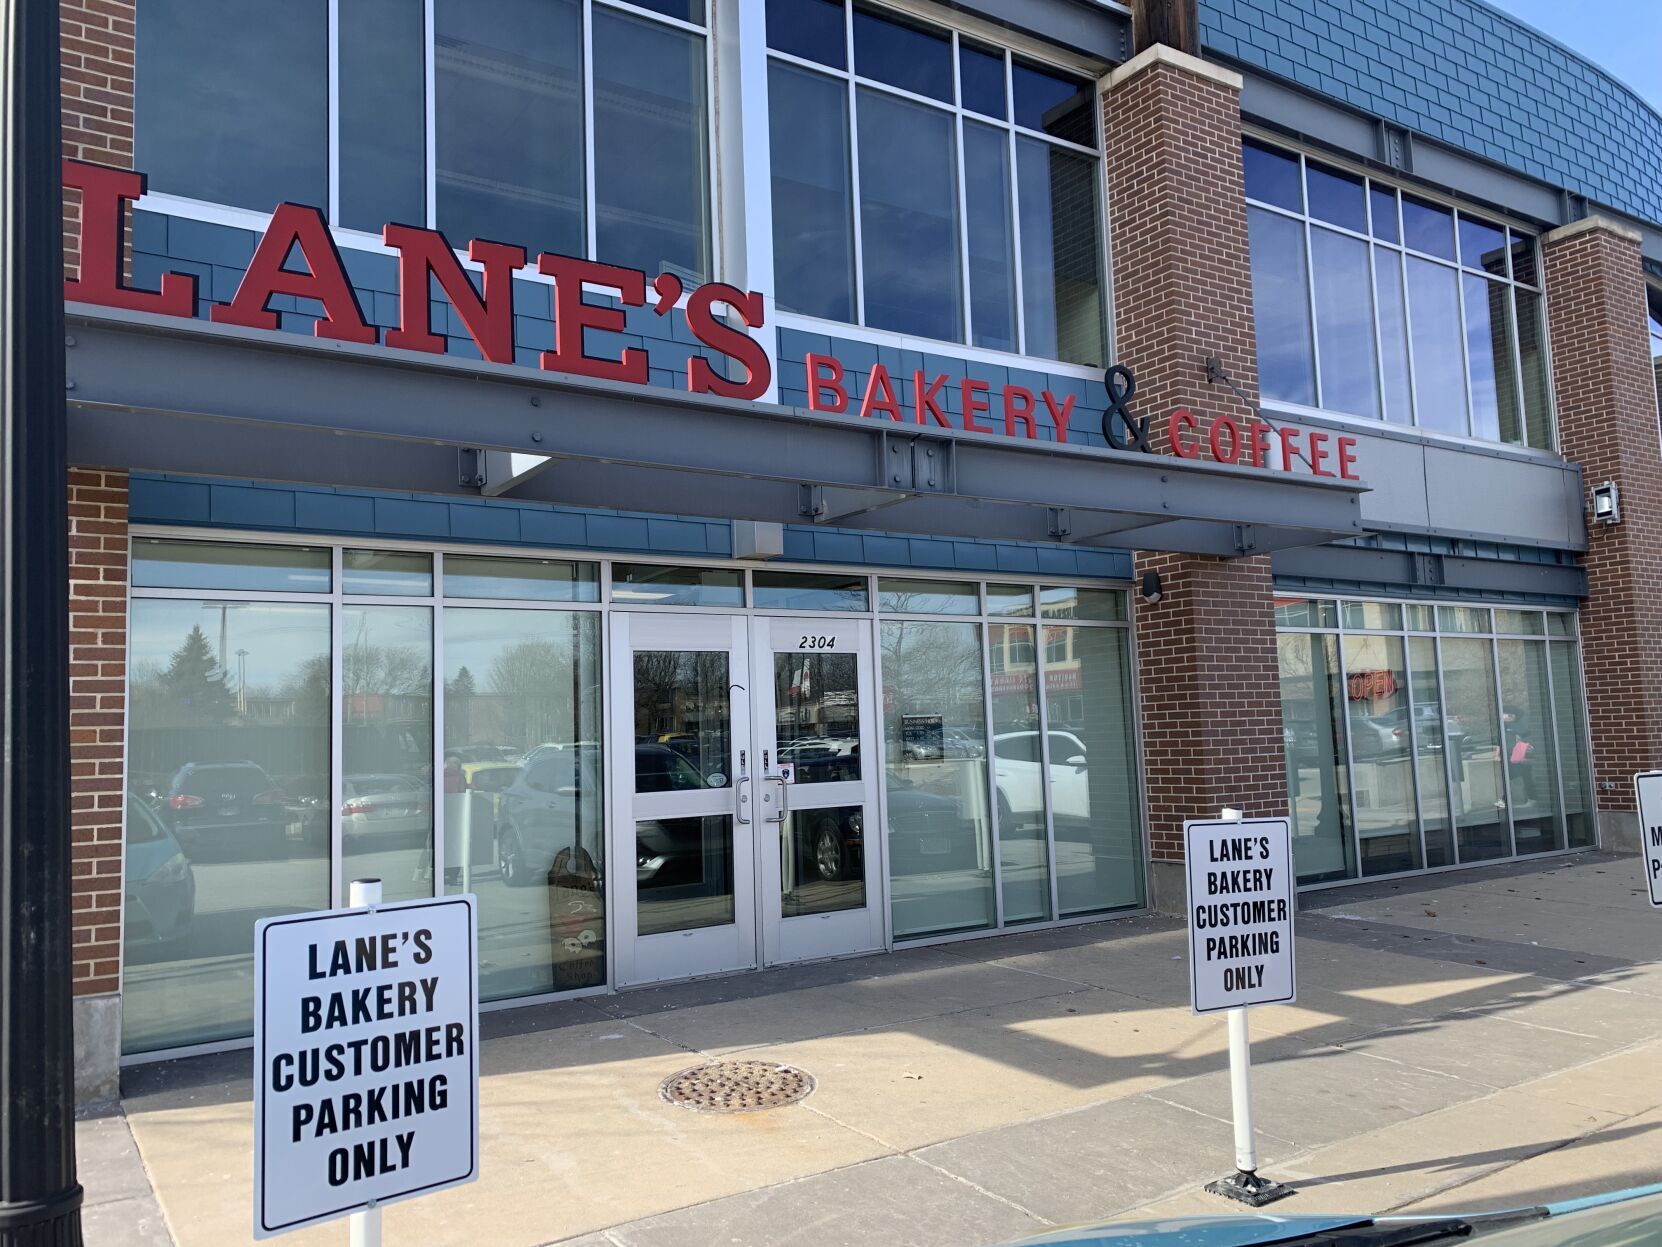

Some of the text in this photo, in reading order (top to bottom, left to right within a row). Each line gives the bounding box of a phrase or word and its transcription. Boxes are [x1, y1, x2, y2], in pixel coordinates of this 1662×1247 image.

[63, 160, 1360, 480] LANE'S BAKERY & COFFEE
[798, 635, 836, 650] 2304
[1351, 670, 1394, 702] OPEN
[1208, 837, 1270, 862] LANE'S
[1206, 867, 1273, 895] BAKERY
[1195, 898, 1287, 929] CUSTOMER
[308, 928, 433, 980] LANE'S
[1205, 931, 1280, 961] PARKING
[1223, 964, 1265, 992] ONLY
[301, 976, 439, 1034] BAKERY
[272, 1022, 464, 1093] CUSTOMER
[292, 1074, 448, 1143] PARKING
[328, 1131, 415, 1187] ONLY
